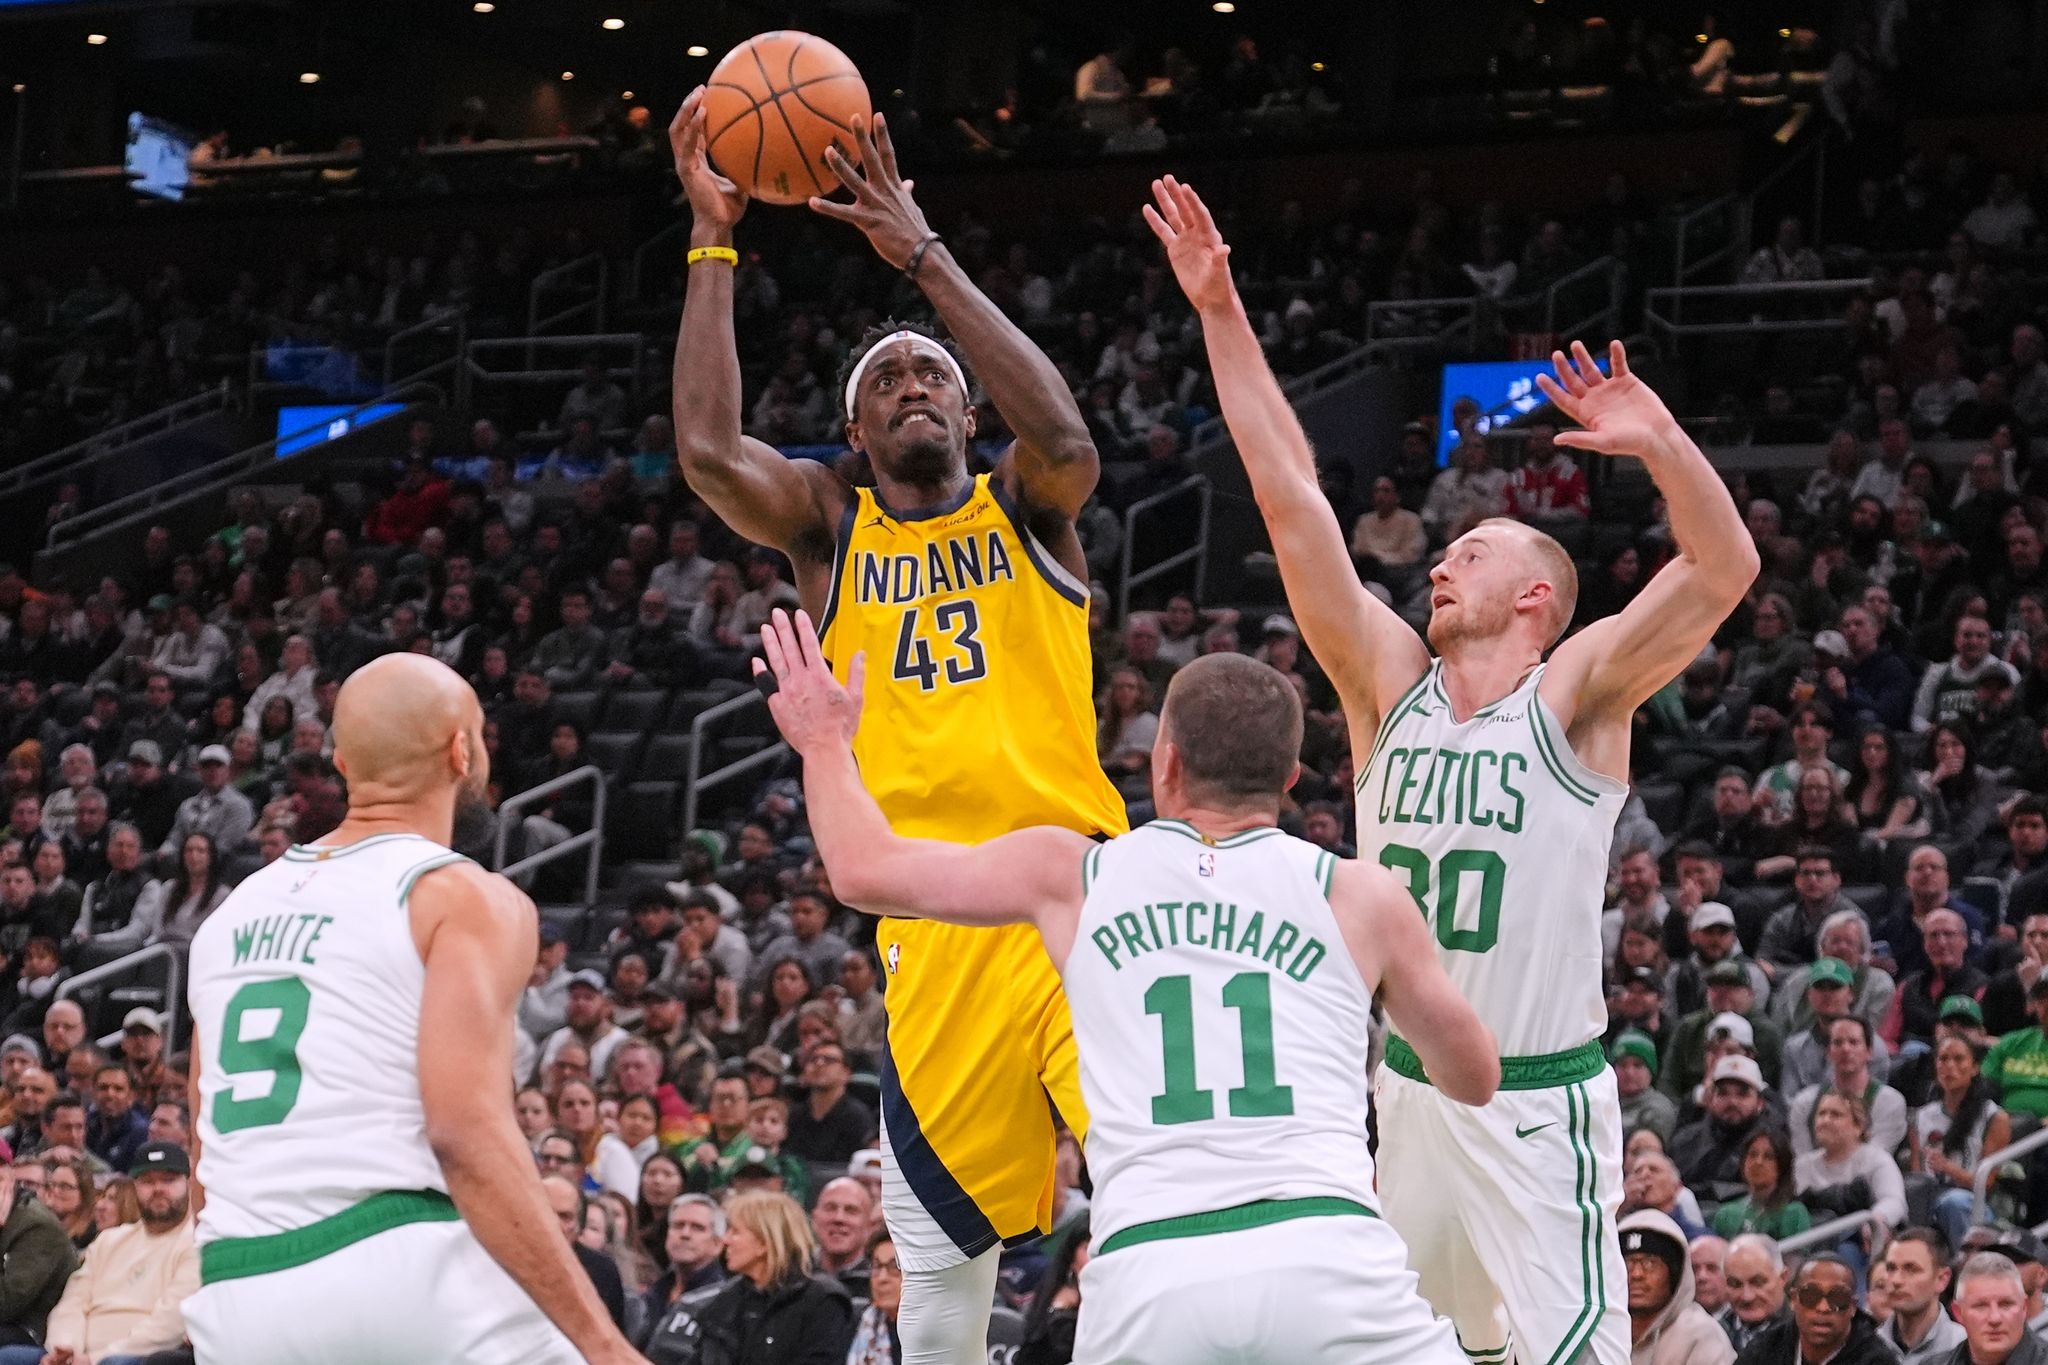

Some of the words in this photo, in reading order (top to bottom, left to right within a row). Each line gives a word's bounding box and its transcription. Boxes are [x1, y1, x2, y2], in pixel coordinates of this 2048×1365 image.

[976, 501, 990, 515] OIL
[893, 599, 987, 691] 43
[1379, 747, 1527, 834] CELTICS
[232, 913, 335, 967] WHITE
[1091, 901, 1326, 983] PRITCHARD
[211, 974, 312, 1135] 9
[1144, 971, 1295, 1126] 11
